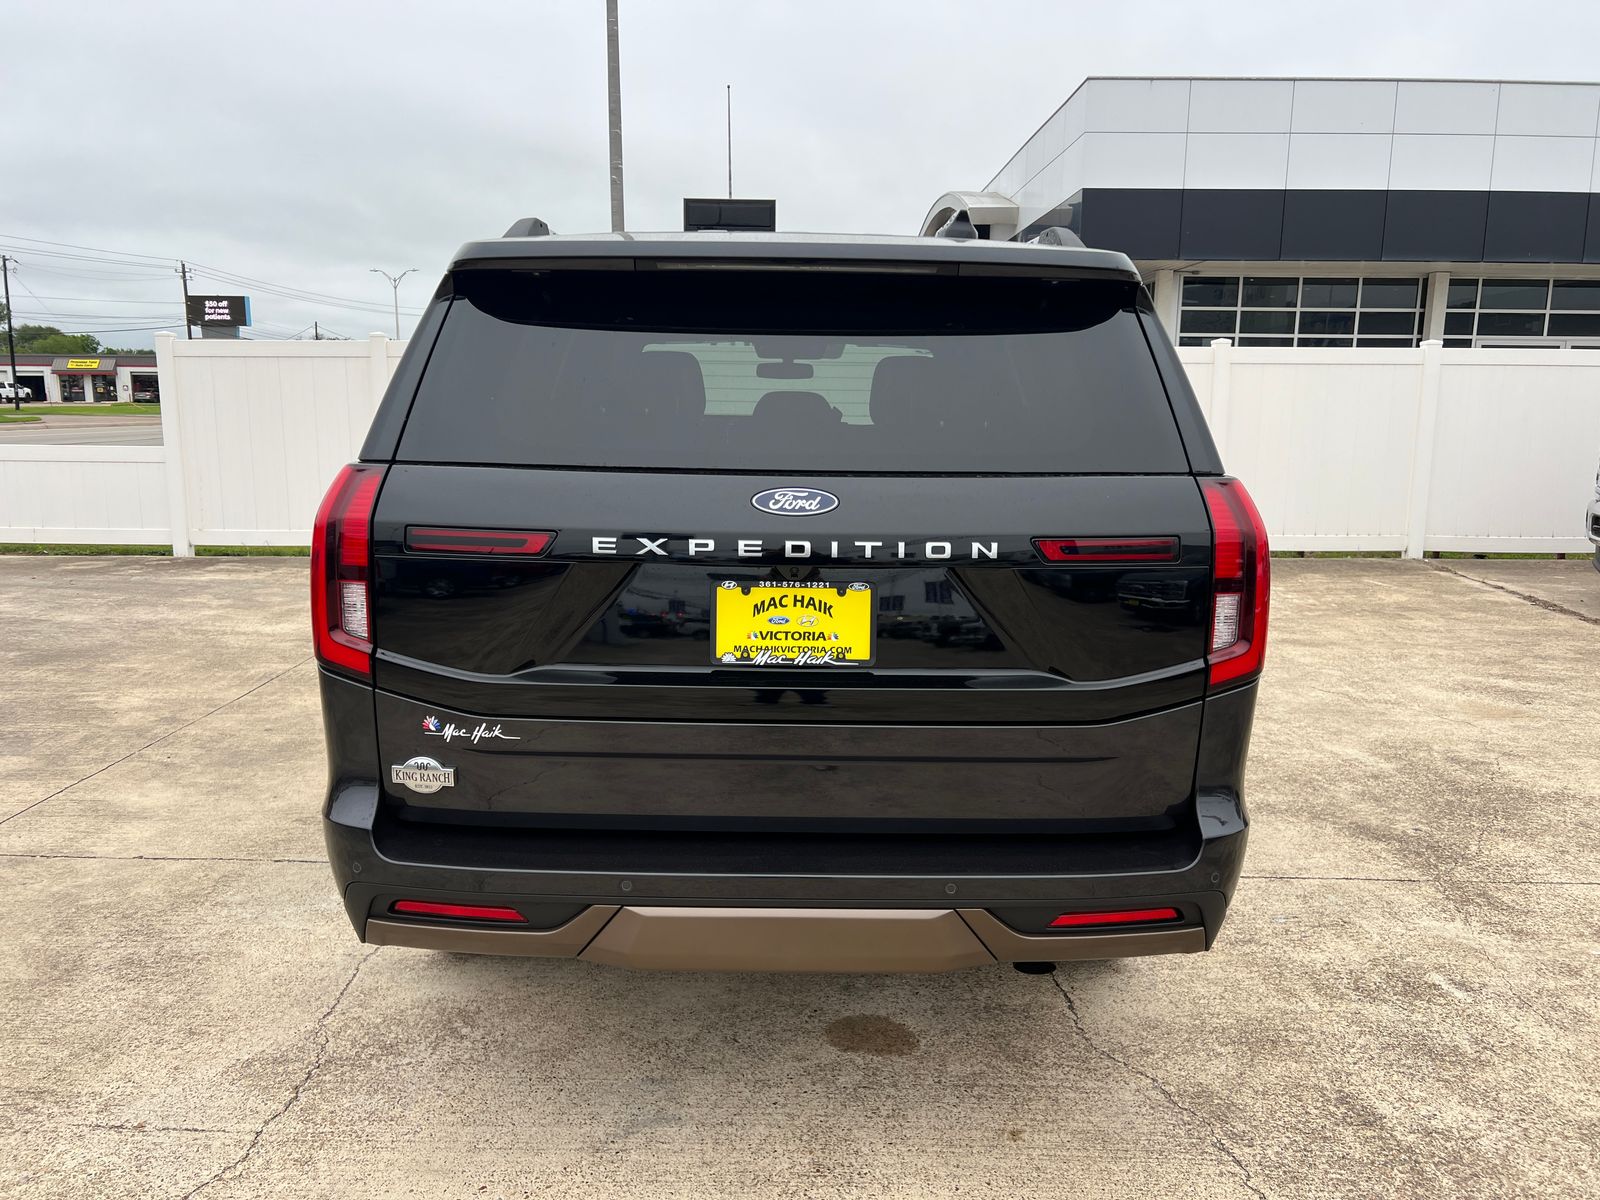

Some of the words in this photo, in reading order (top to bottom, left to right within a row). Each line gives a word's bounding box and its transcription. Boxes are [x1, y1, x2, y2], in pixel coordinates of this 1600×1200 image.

[769, 491, 821, 511] Ford
[592, 537, 998, 559] EXPEDITION
[753, 594, 789, 618] MAC
[793, 594, 834, 618] HAIK
[770, 616, 788, 625] Ford
[758, 630, 827, 641] VICTORIA
[747, 650, 793, 666] Mac
[793, 650, 842, 666] Haik
[440, 723, 471, 743] Mac
[471, 722, 508, 744] Haik
[395, 769, 418, 782] KING
[419, 772, 450, 784] RANCH
